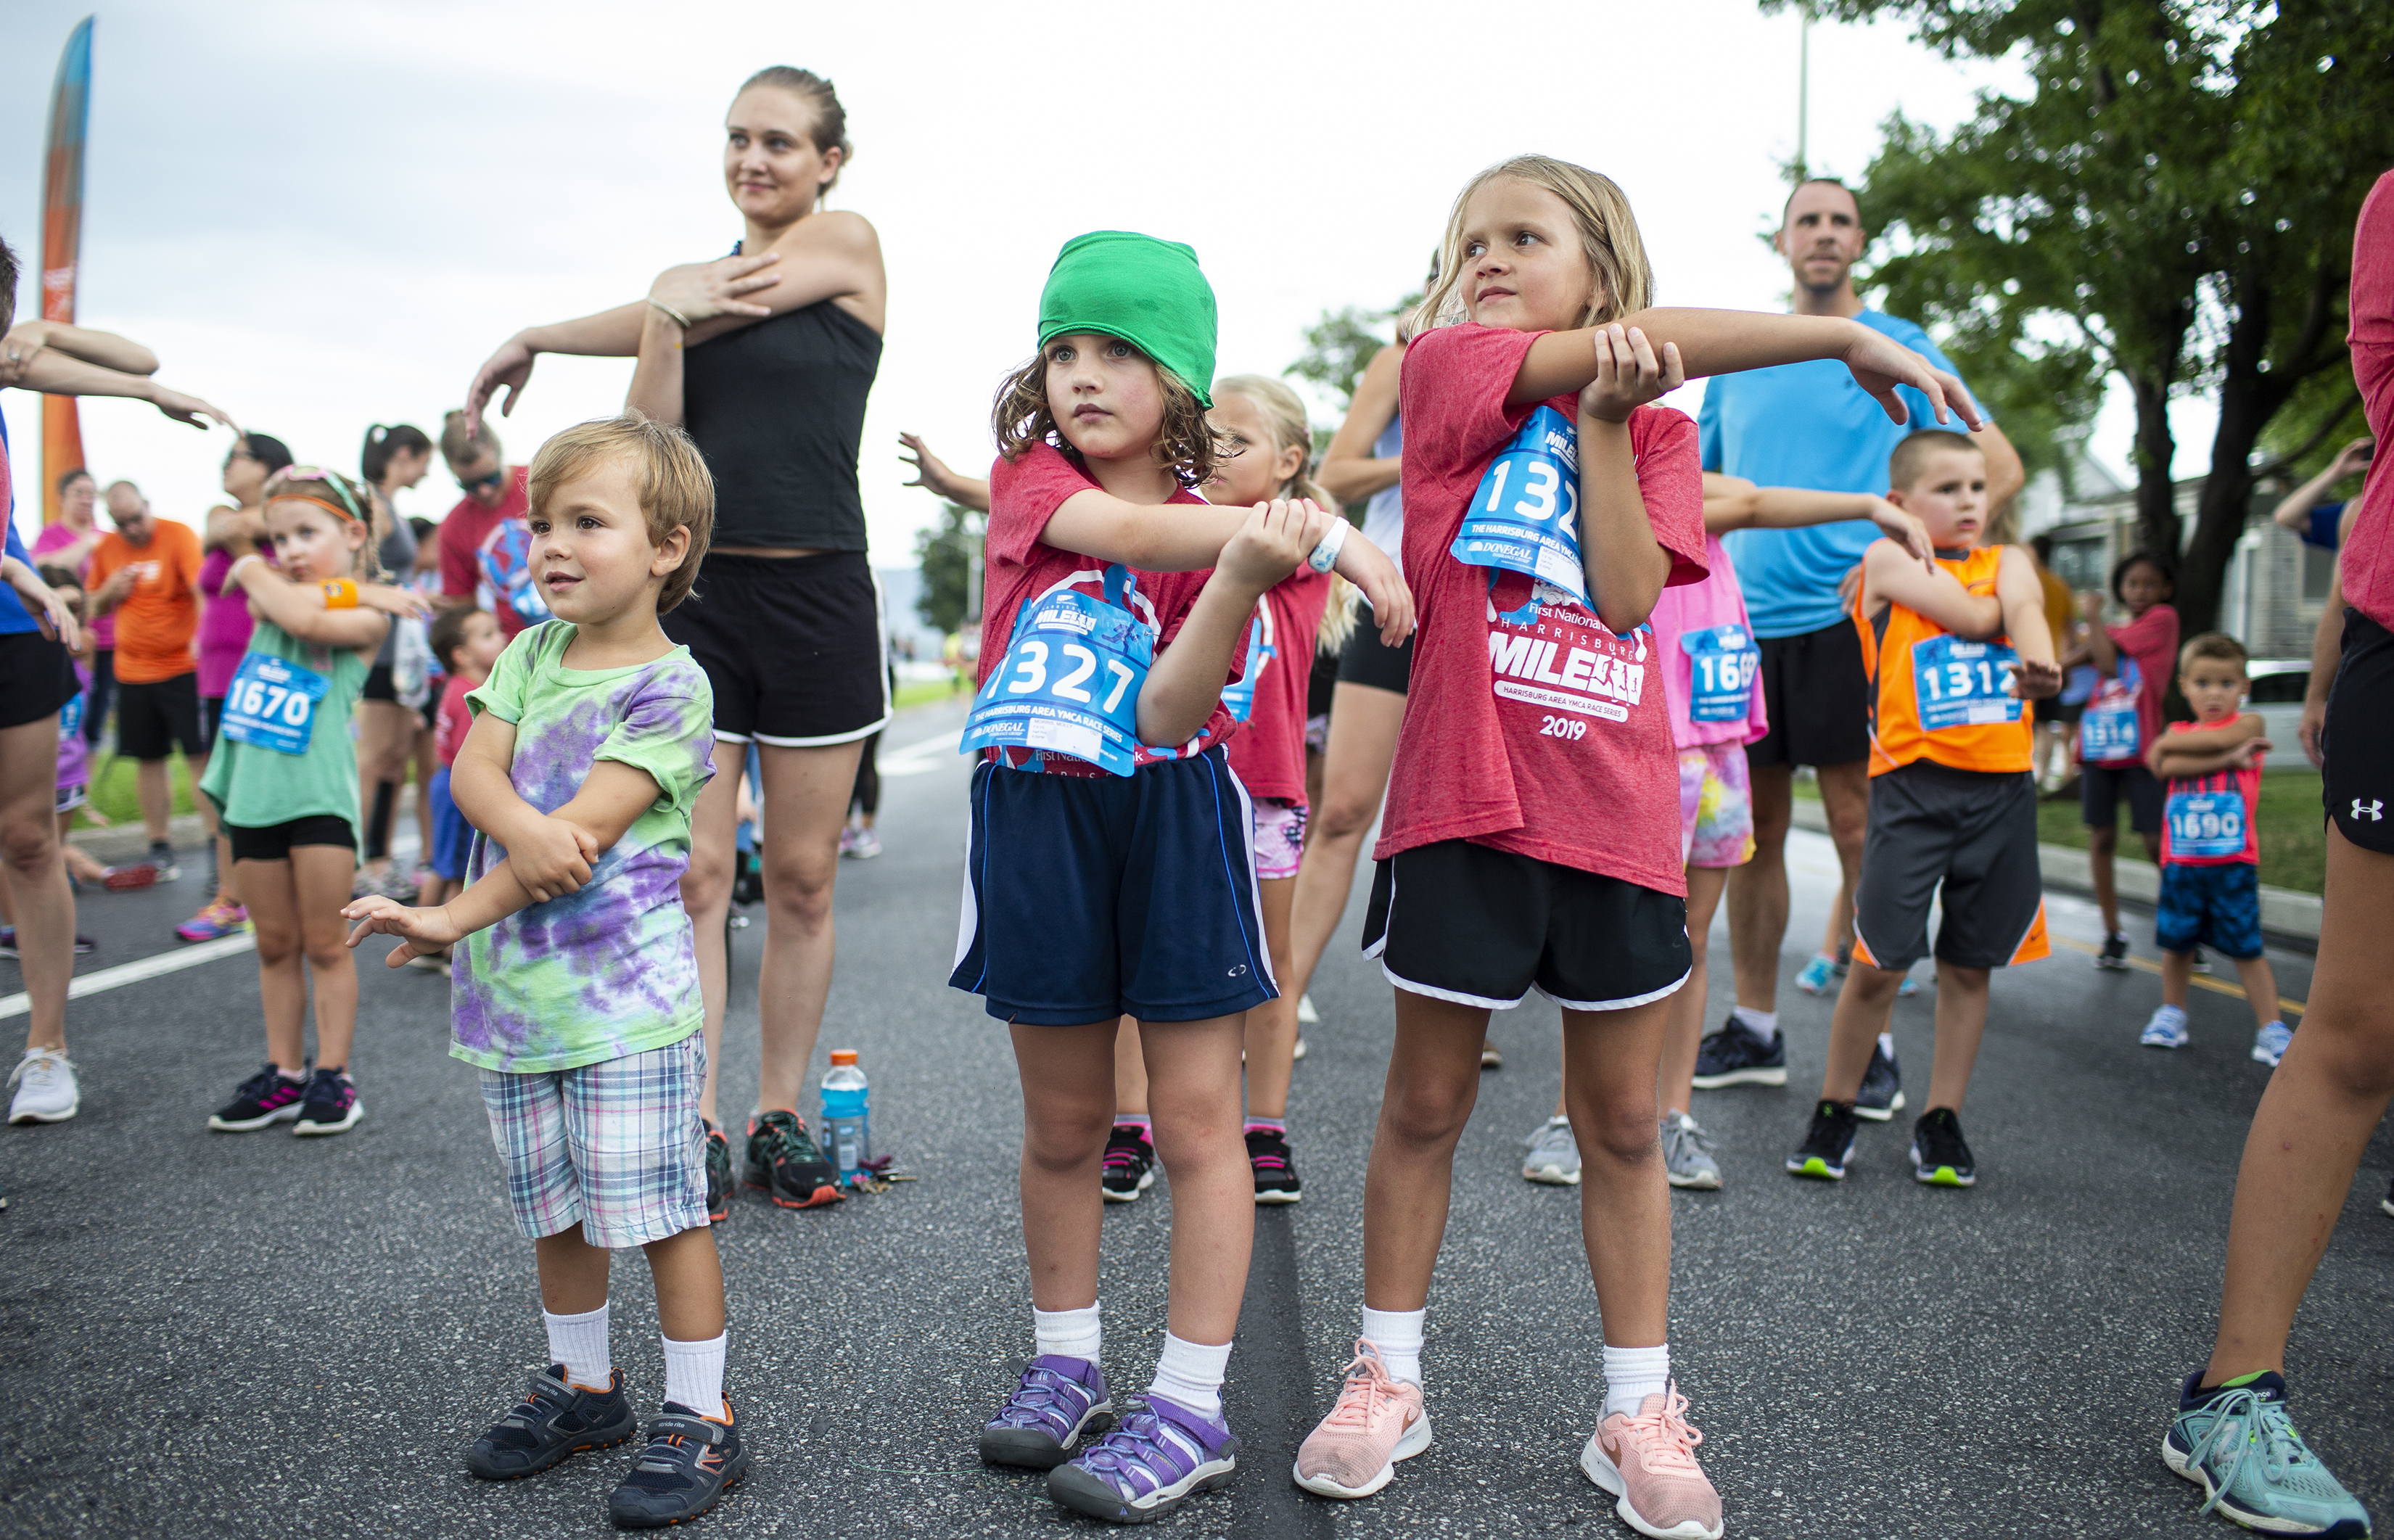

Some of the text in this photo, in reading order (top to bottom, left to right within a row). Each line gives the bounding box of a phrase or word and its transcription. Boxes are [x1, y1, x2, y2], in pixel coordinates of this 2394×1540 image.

[1544, 431, 1576, 459] MILE
[1486, 460, 1578, 543] 132
[1471, 524, 1575, 561] THE HARRISBURG AREA YMCA
[1482, 543, 1533, 560] DONEGAL
[1035, 609, 1074, 625] MILE
[1042, 605, 1092, 617] HARRISBURG
[1528, 601, 1552, 618] First
[1554, 607, 1600, 630] National
[1501, 617, 1633, 661] HARRISBURG
[1489, 631, 1597, 691] MILE
[987, 641, 1134, 714] 1327
[1925, 660, 2015, 701] 1312
[229, 678, 309, 726] 1670
[1503, 686, 1621, 717] HARRISBURG AREA YMCA RACE SERIES
[975, 705, 1122, 743] THE HARRISBURG AREA YMCA RACE SERIES
[982, 722, 1025, 735] DONEGAL
[1539, 715, 1587, 741] 2019
[1036, 750, 1054, 762] First
[2172, 812, 2239, 839] 1690
[537, 1383, 548, 1391] stride
